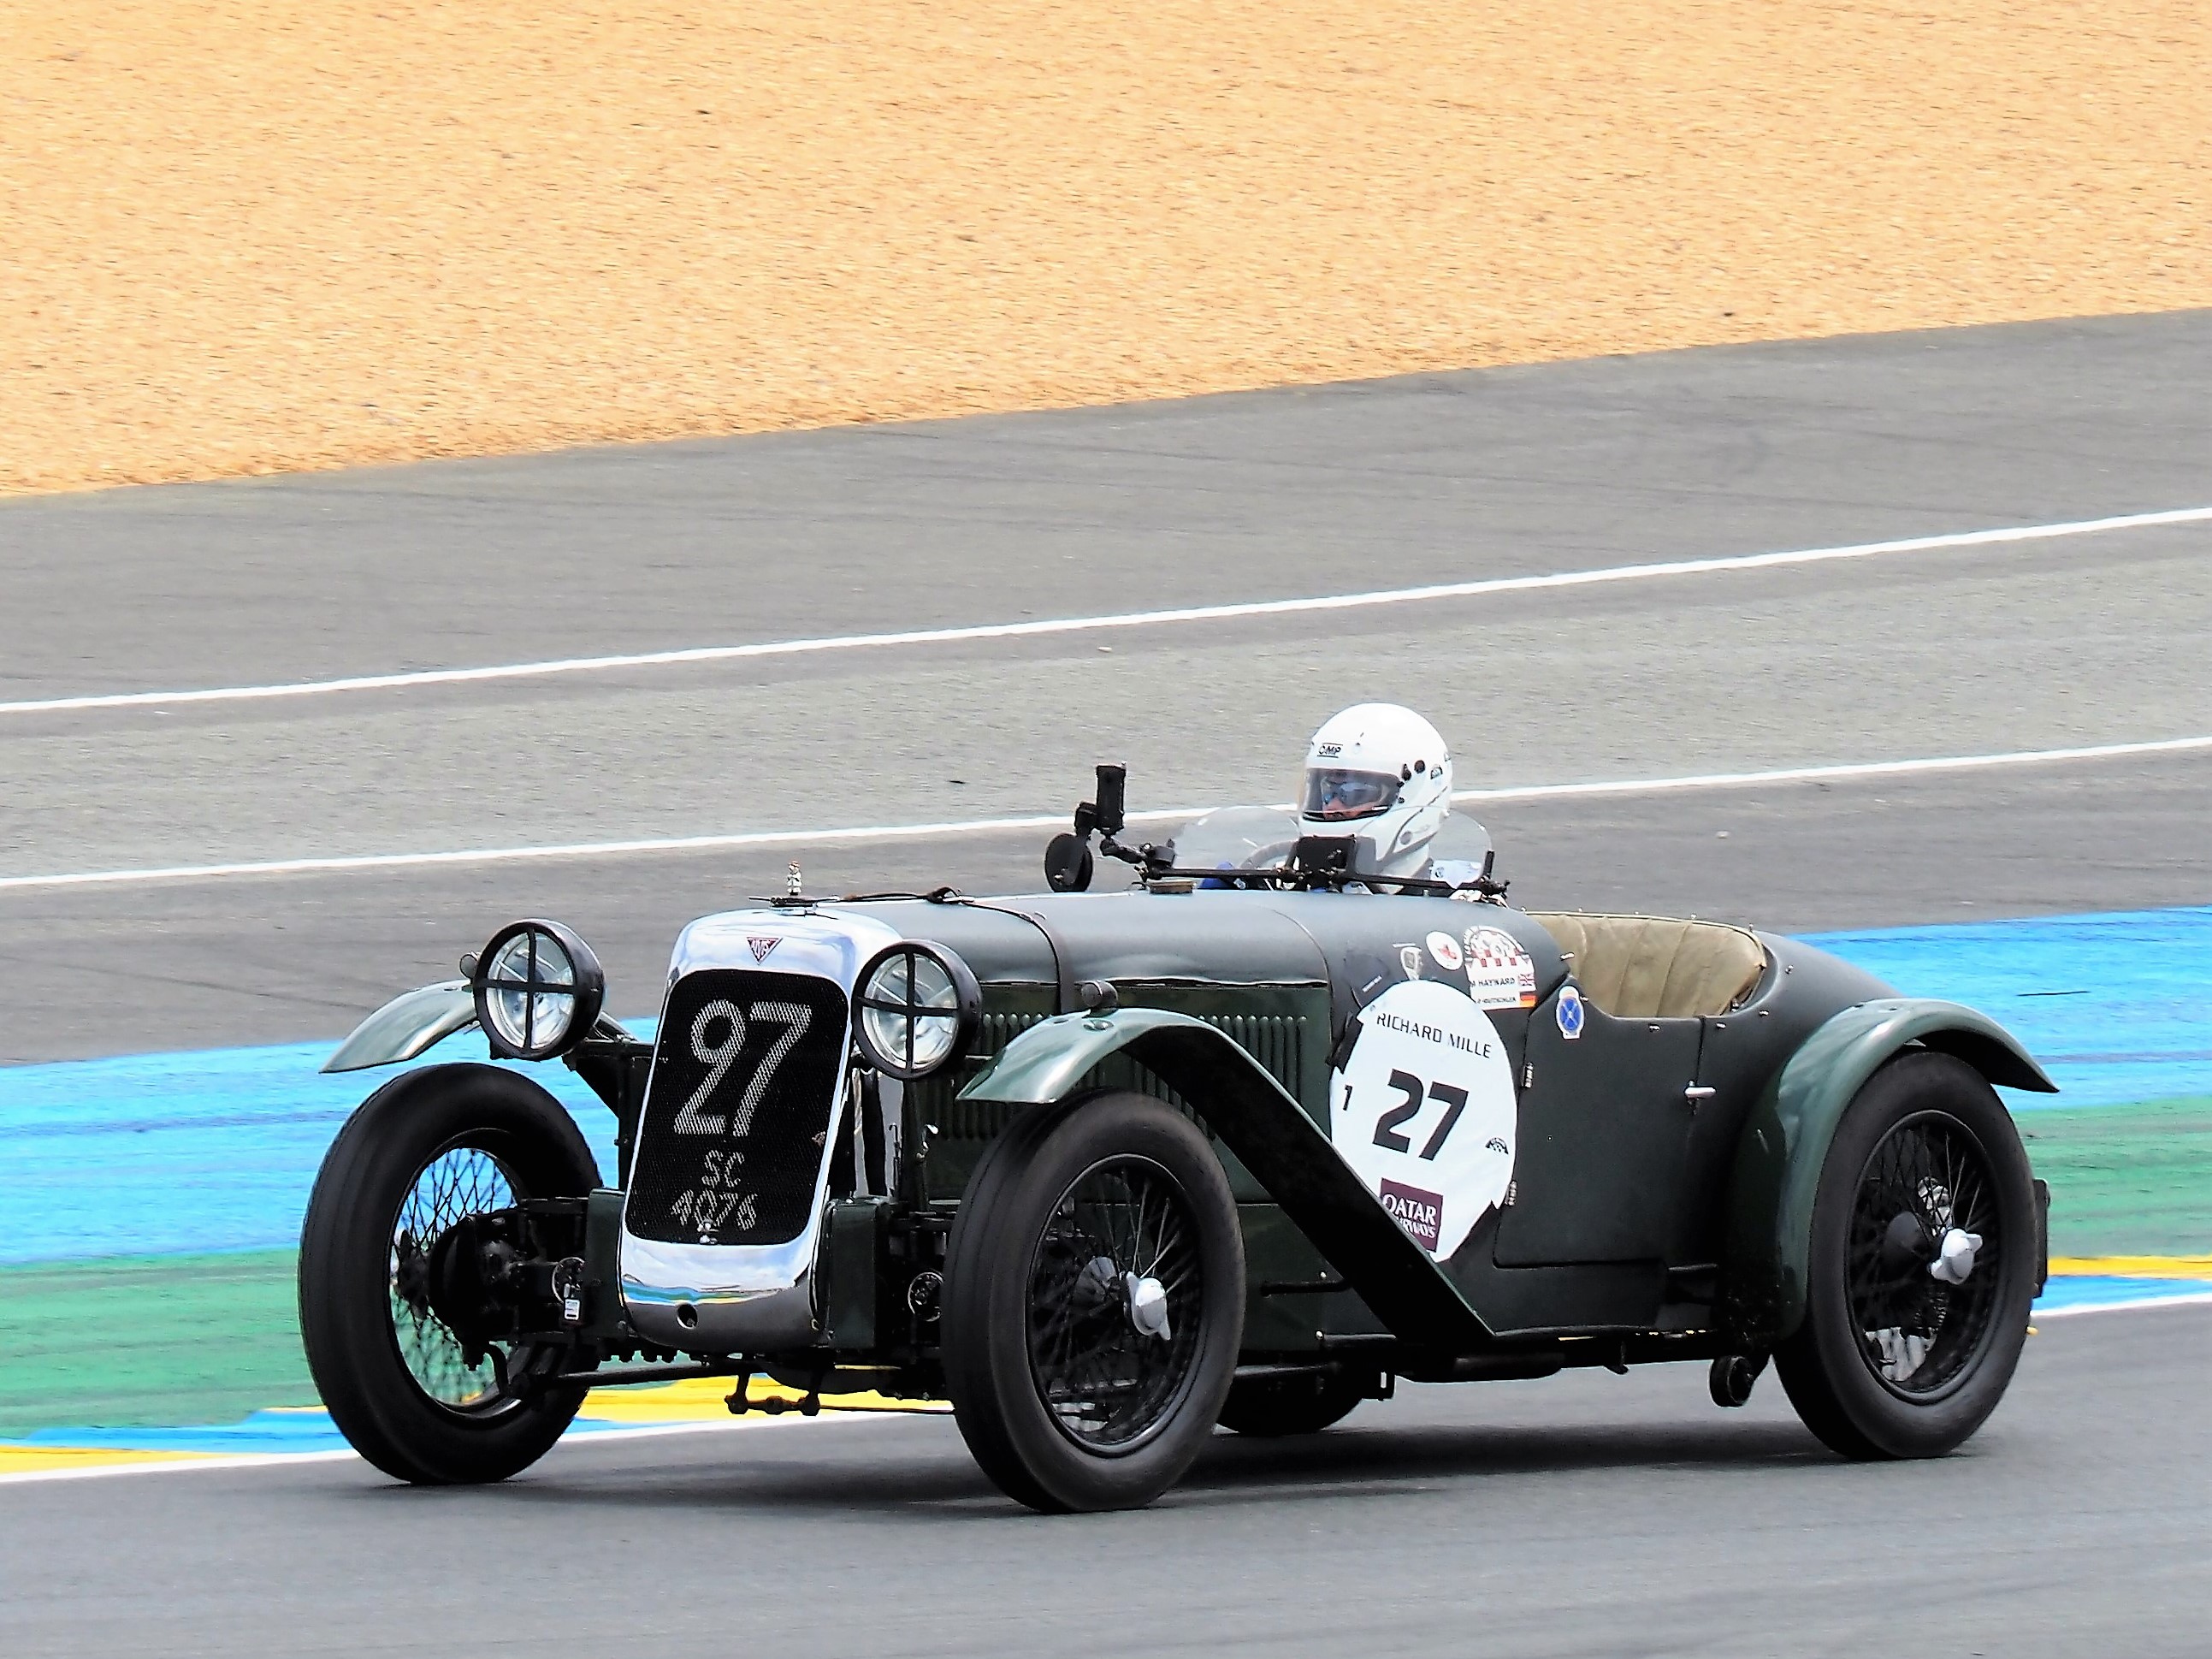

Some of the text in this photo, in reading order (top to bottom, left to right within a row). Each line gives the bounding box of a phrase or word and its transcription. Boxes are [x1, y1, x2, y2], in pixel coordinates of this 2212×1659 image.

[1376, 1013, 1442, 1043] RICHARD
[1372, 1068, 1470, 1161] 27
[701, 1149, 745, 1189] SC
[1382, 1194, 1436, 1226] QATAR
